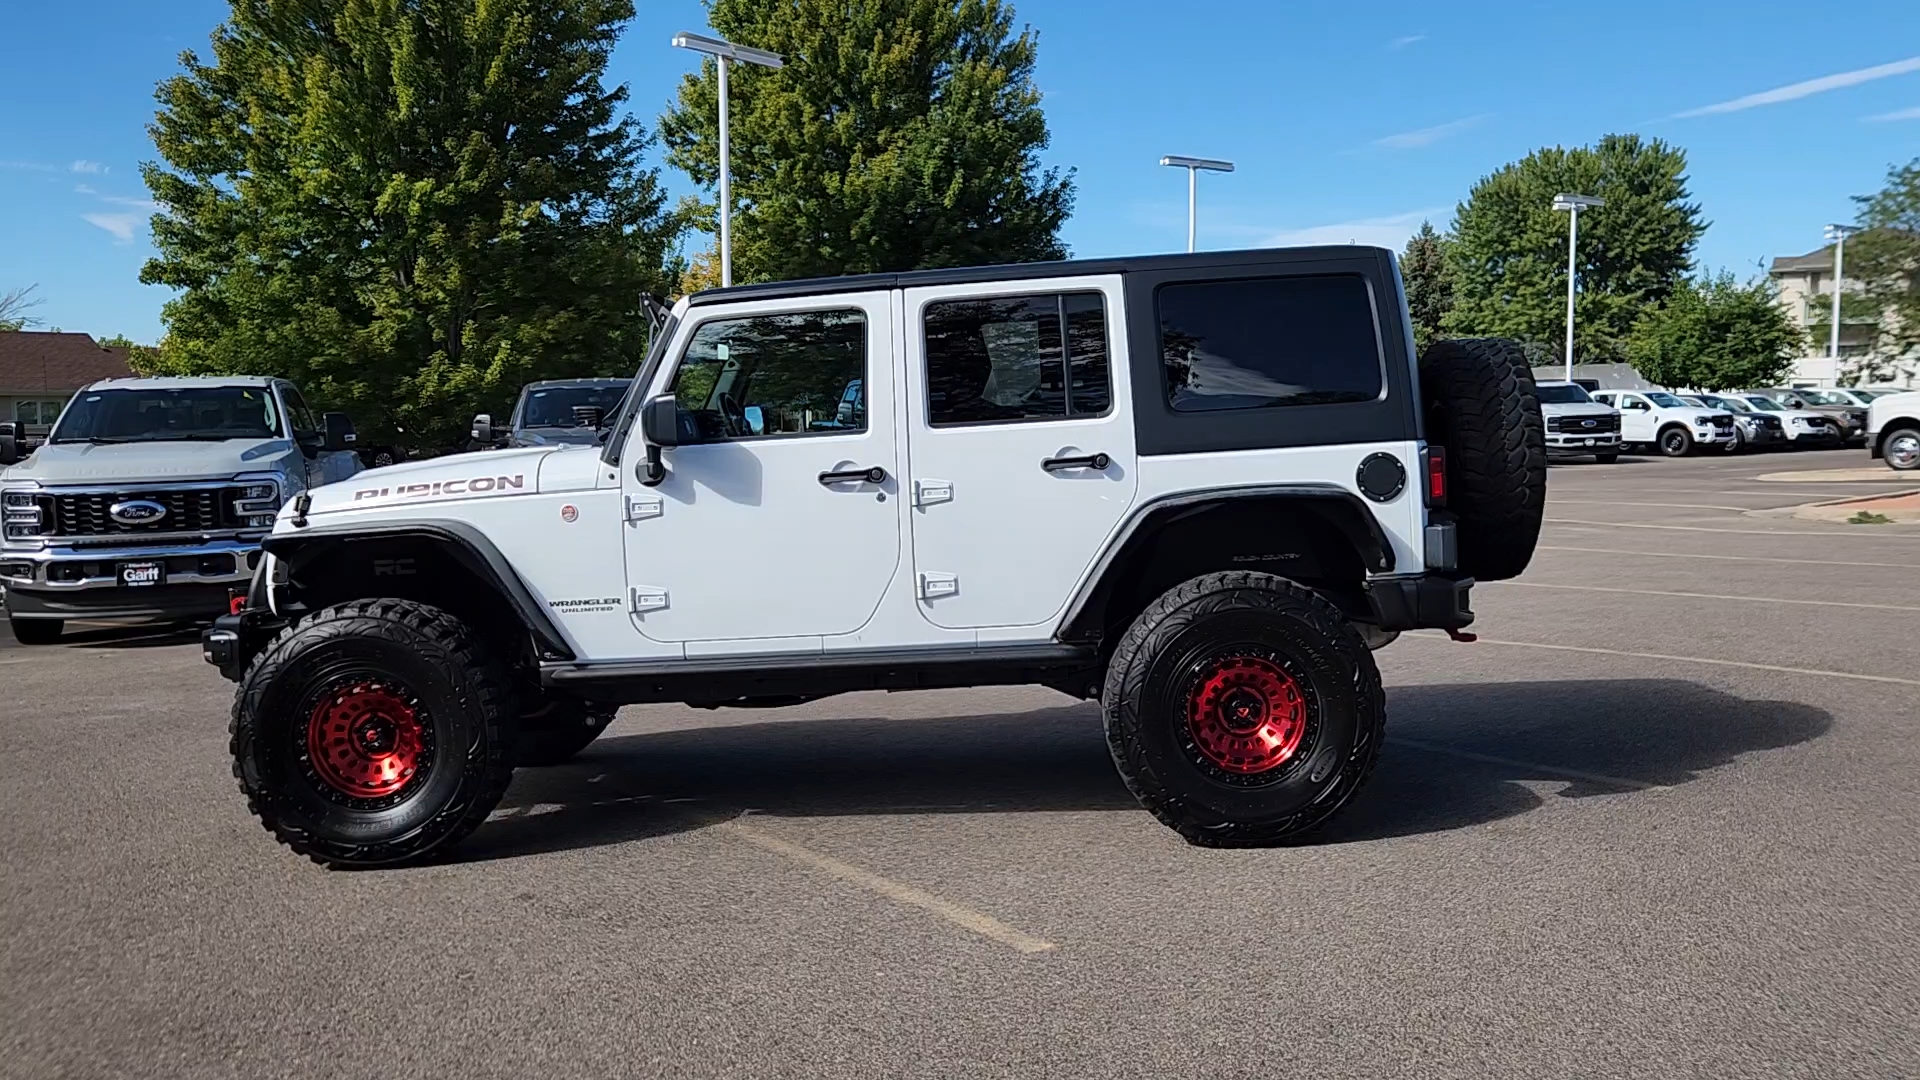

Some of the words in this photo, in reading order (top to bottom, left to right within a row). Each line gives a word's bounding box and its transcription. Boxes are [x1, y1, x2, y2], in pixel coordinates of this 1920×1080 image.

[354, 475, 524, 501] RUBICON
[124, 508, 150, 517] Ford
[373, 558, 417, 576] RC
[123, 567, 159, 582] Garff
[549, 597, 622, 607] WRANGLER
[561, 606, 614, 614] UNLIMITED
